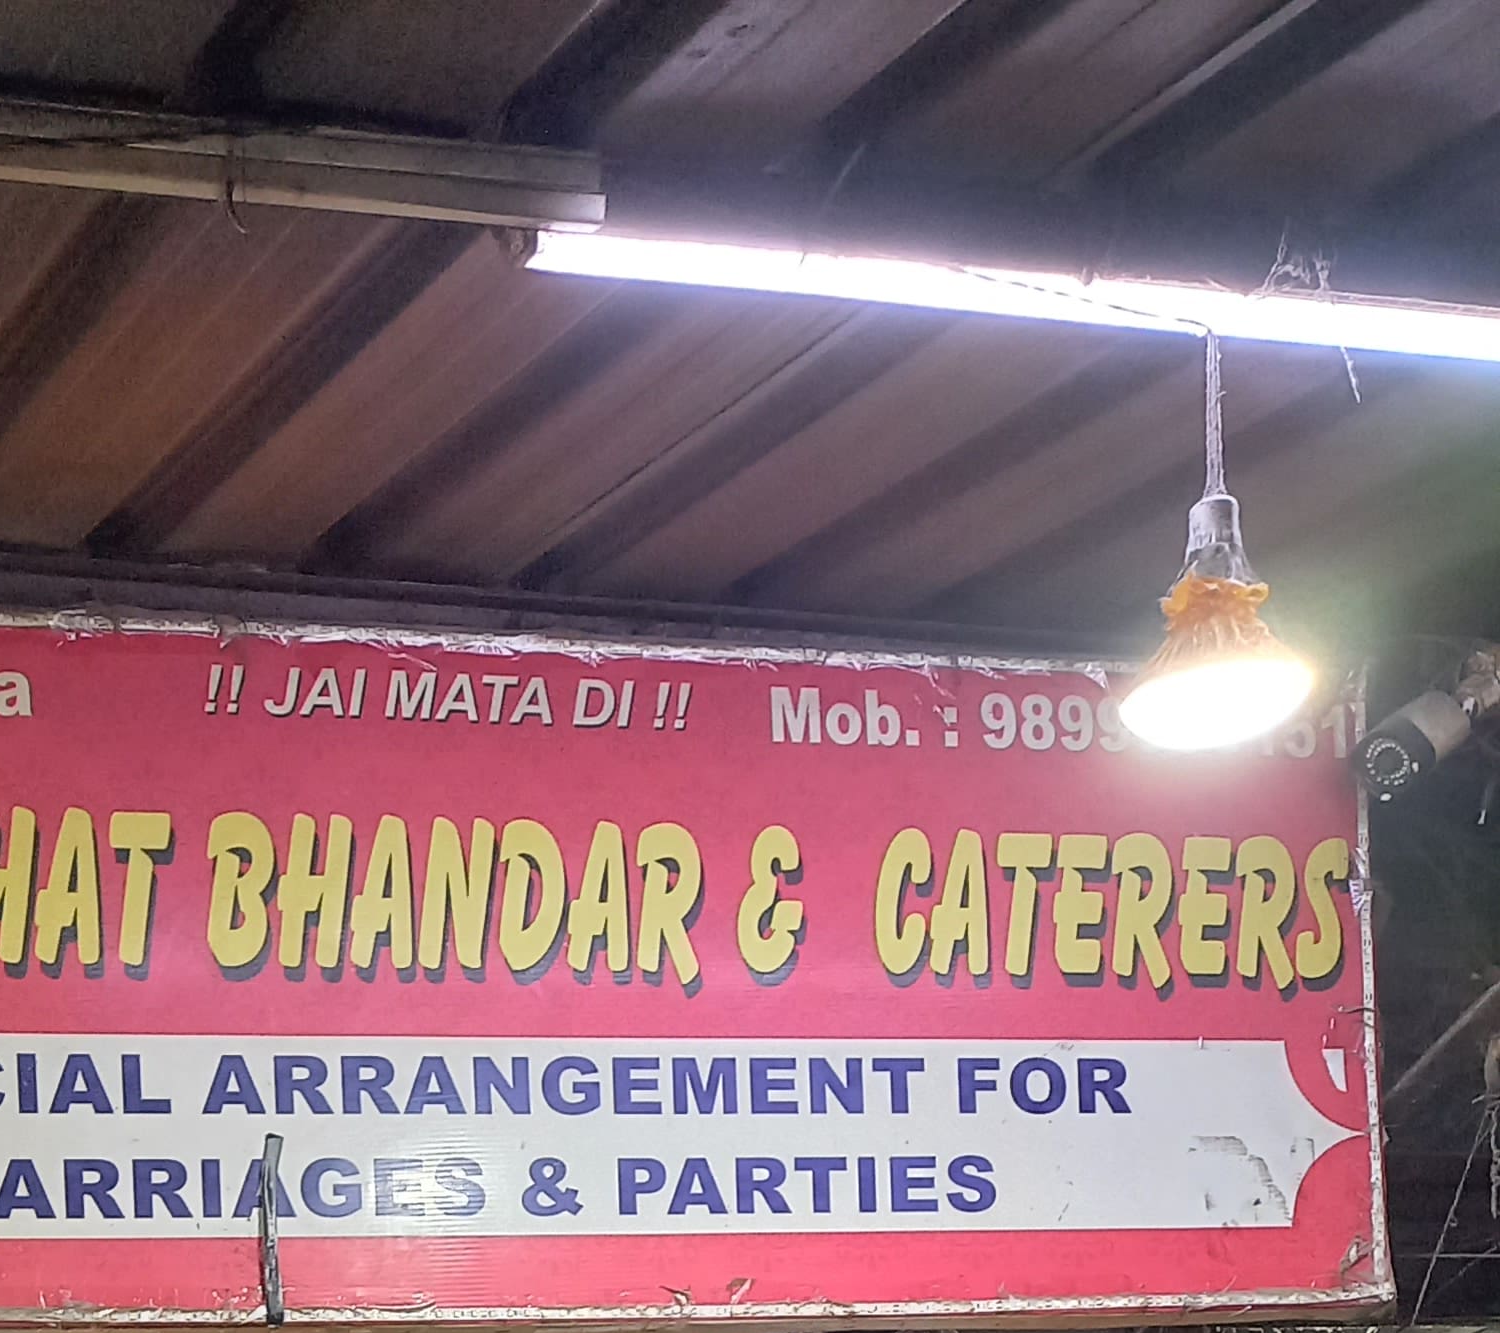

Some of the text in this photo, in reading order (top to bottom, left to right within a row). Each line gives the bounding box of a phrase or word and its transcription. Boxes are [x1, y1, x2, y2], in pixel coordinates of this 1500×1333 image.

[263, 669, 365, 721] JAI
[385, 671, 553, 728] MATA
[571, 677, 636, 730] DI
[770, 686, 921, 748] Mob.
[204, 812, 702, 992] BHANDAR
[736, 824, 806, 985] &
[873, 826, 1350, 998] CATERERS
[201, 1053, 925, 1117] ARRANGEMENT
[956, 1056, 1132, 1116] FOR
[522, 1157, 584, 1217] &
[617, 1153, 998, 1217] PARTIES
